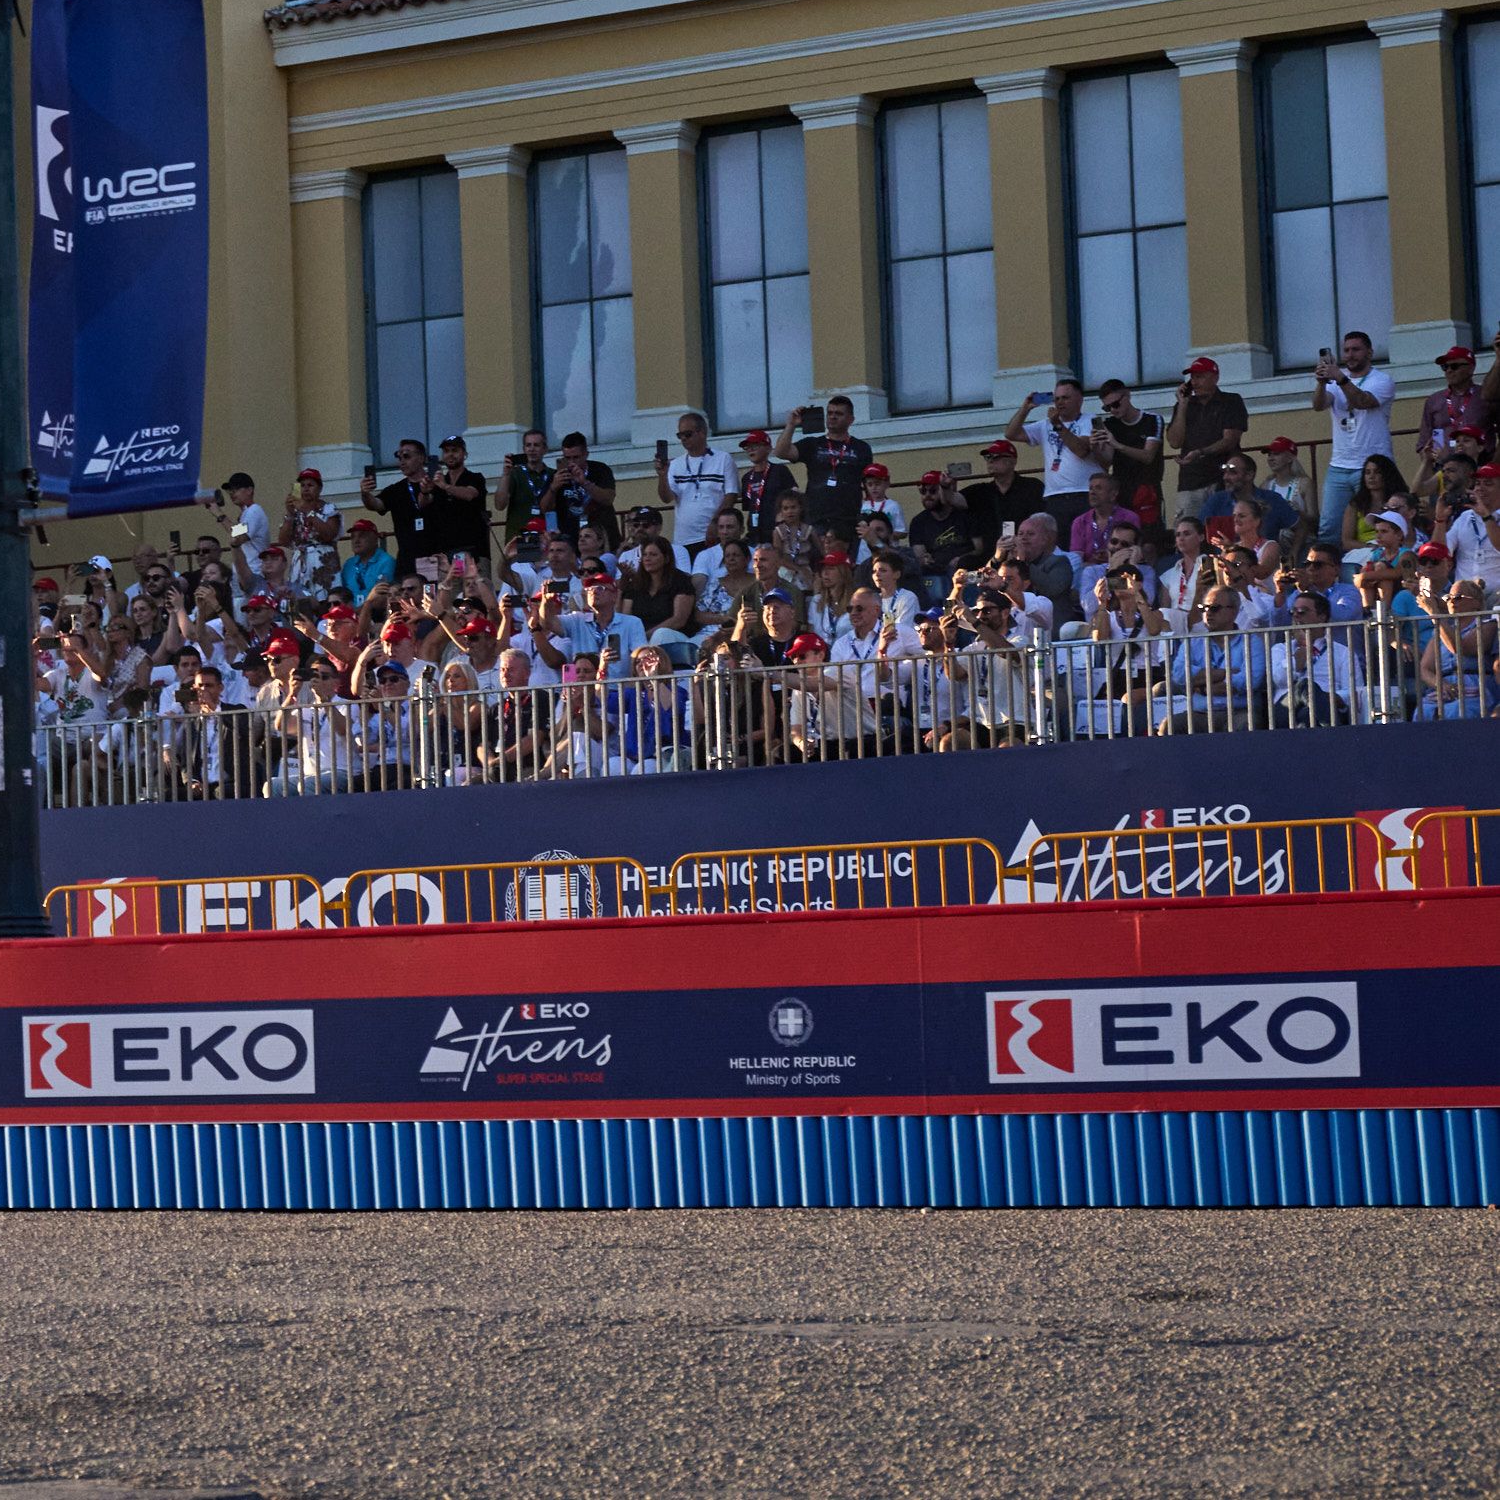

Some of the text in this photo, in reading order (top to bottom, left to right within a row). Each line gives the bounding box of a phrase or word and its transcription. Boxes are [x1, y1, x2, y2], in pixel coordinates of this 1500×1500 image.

[83, 162, 196, 202] WRC
[153, 425, 180, 436] EKO
[1172, 804, 1251, 827] EKO
[622, 852, 913, 892] HELLENIC REPUBLIC
[186, 873, 445, 933] EKO
[540, 1002, 590, 1019] EKO
[1100, 996, 1351, 1065] EKO
[112, 1022, 308, 1082] EKO
[729, 1055, 857, 1069] HELLENIC REPUBLIC
[746, 1073, 841, 1088] Ministry of Sports
